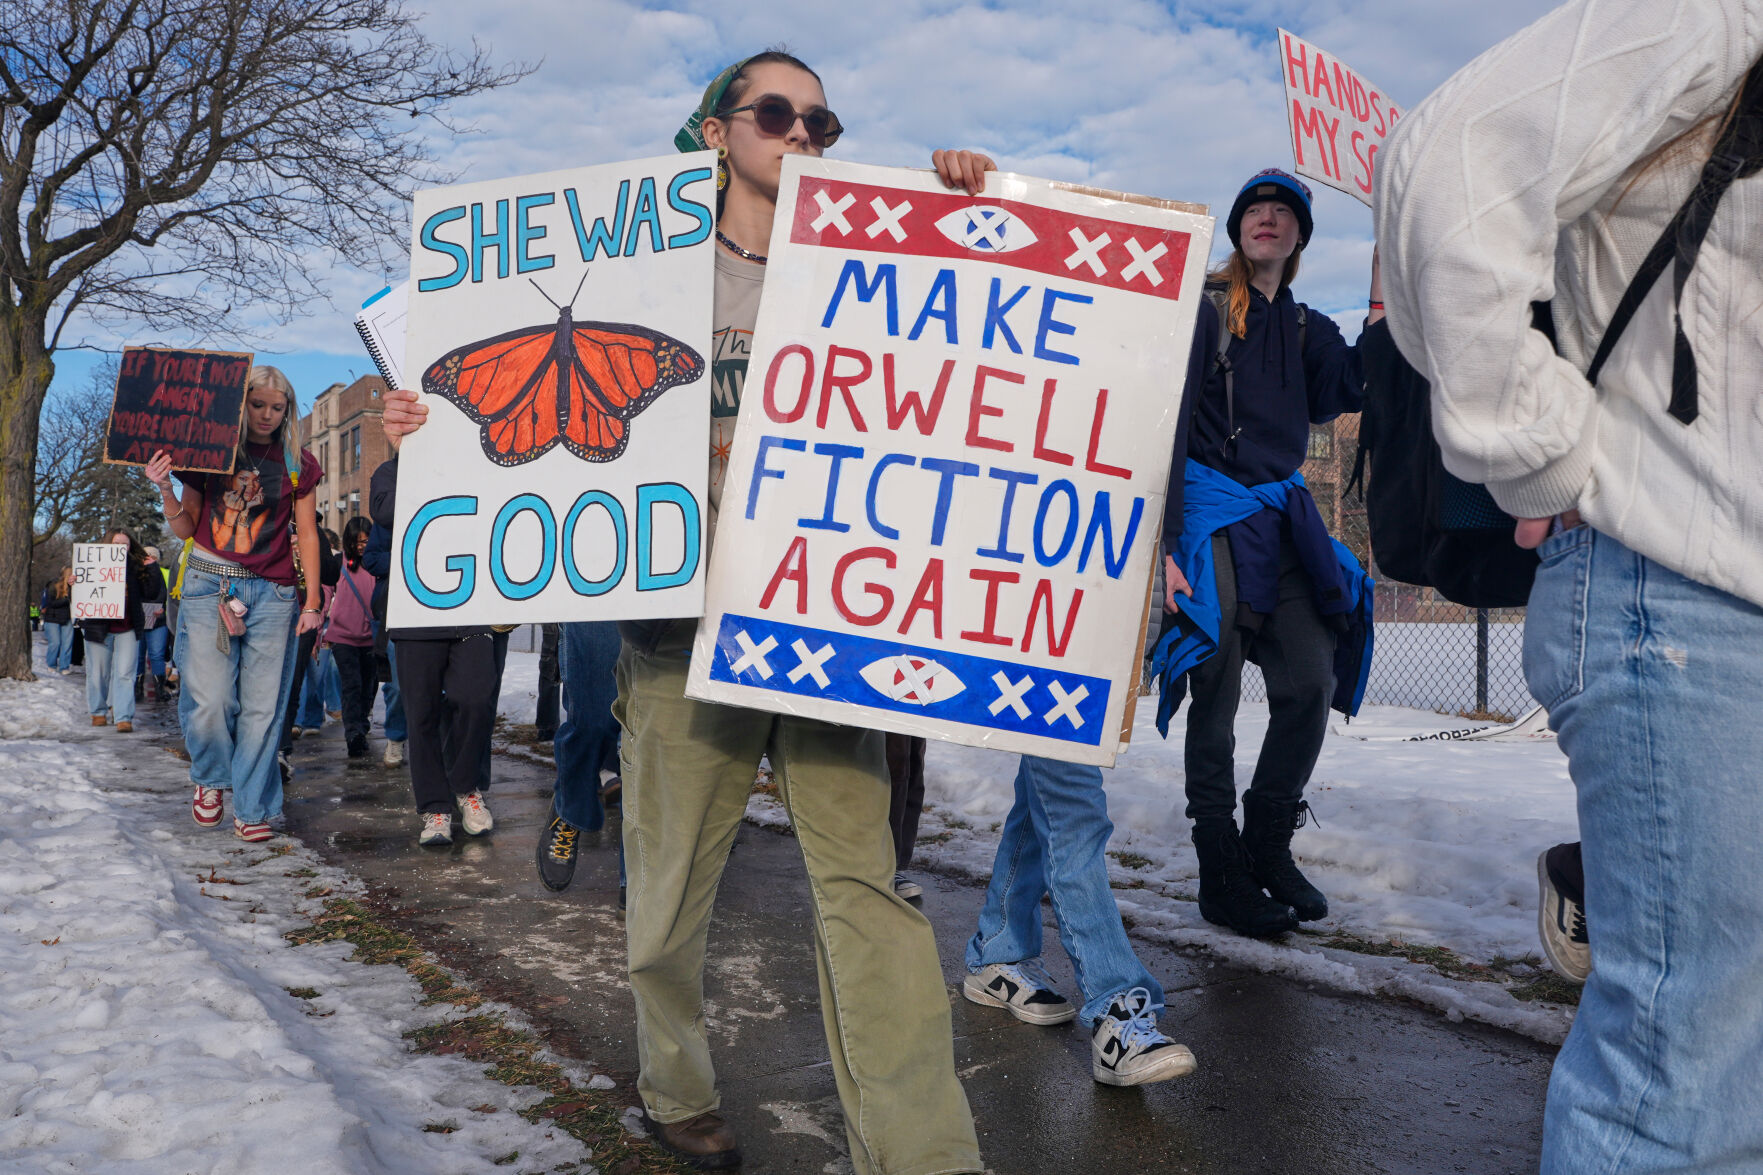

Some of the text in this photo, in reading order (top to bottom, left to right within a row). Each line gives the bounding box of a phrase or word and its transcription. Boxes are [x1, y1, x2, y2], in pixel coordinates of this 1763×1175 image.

[1284, 34, 1386, 138] HANDS
[1293, 99, 1340, 181] MY
[418, 167, 713, 292] SHE WAS
[821, 259, 1094, 366] MAKE
[122, 351, 149, 378] IF
[209, 361, 249, 388] NOT
[148, 382, 216, 417] ANGRY
[160, 414, 191, 442] NOT
[187, 416, 240, 449] PAYING
[762, 343, 1133, 480] ORWELL
[401, 482, 701, 610] GOOD
[745, 436, 1145, 580] FICTION
[75, 566, 126, 584] BE SAFE
[77, 546, 126, 563] LET US
[90, 587, 107, 599] AT
[75, 602, 122, 618] SCHOOL
[758, 536, 1084, 658] AGAIN
